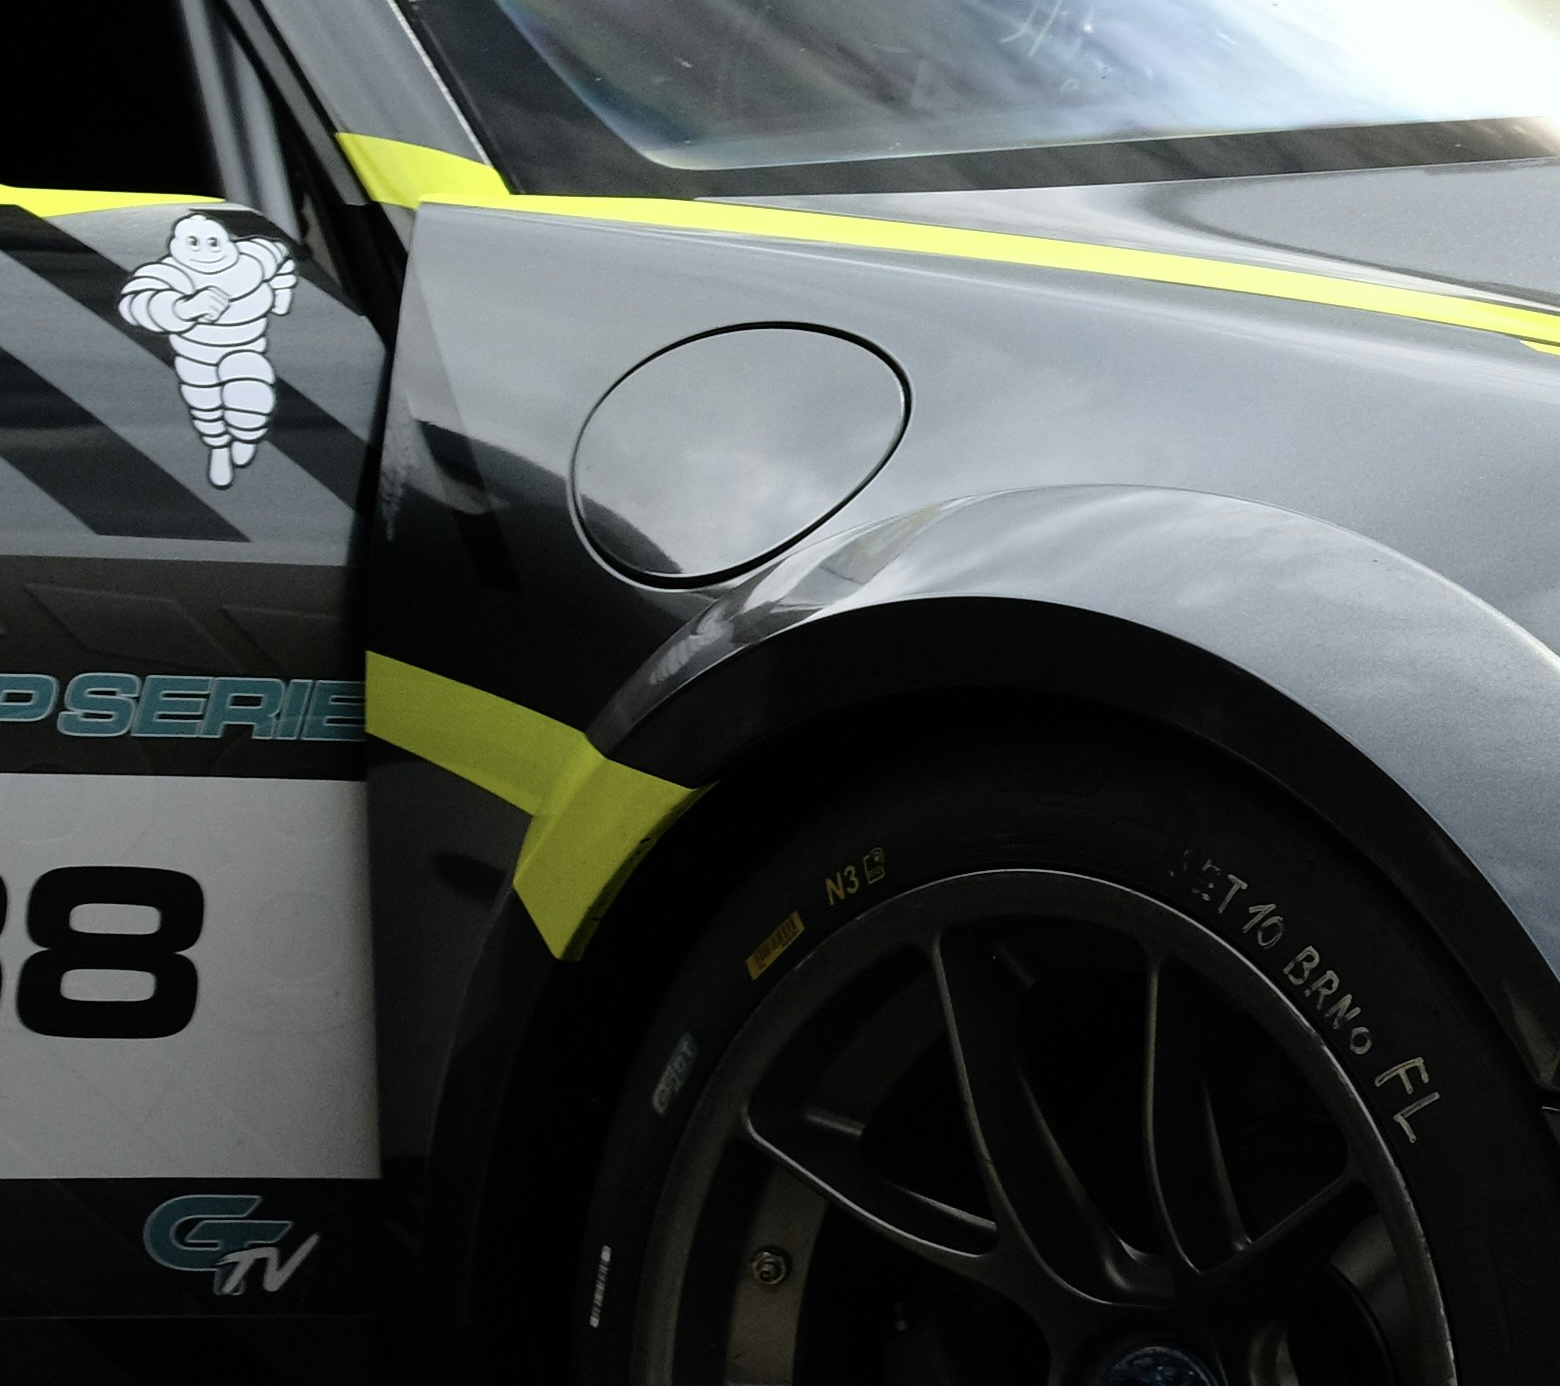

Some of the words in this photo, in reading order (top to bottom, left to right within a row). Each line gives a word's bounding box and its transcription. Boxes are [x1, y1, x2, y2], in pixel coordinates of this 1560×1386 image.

[0, 865, 205, 1040] 8
[1241, 902, 1284, 949] 10
[1282, 945, 1374, 1056] BRNO
[1374, 1056, 1442, 1145] FL
